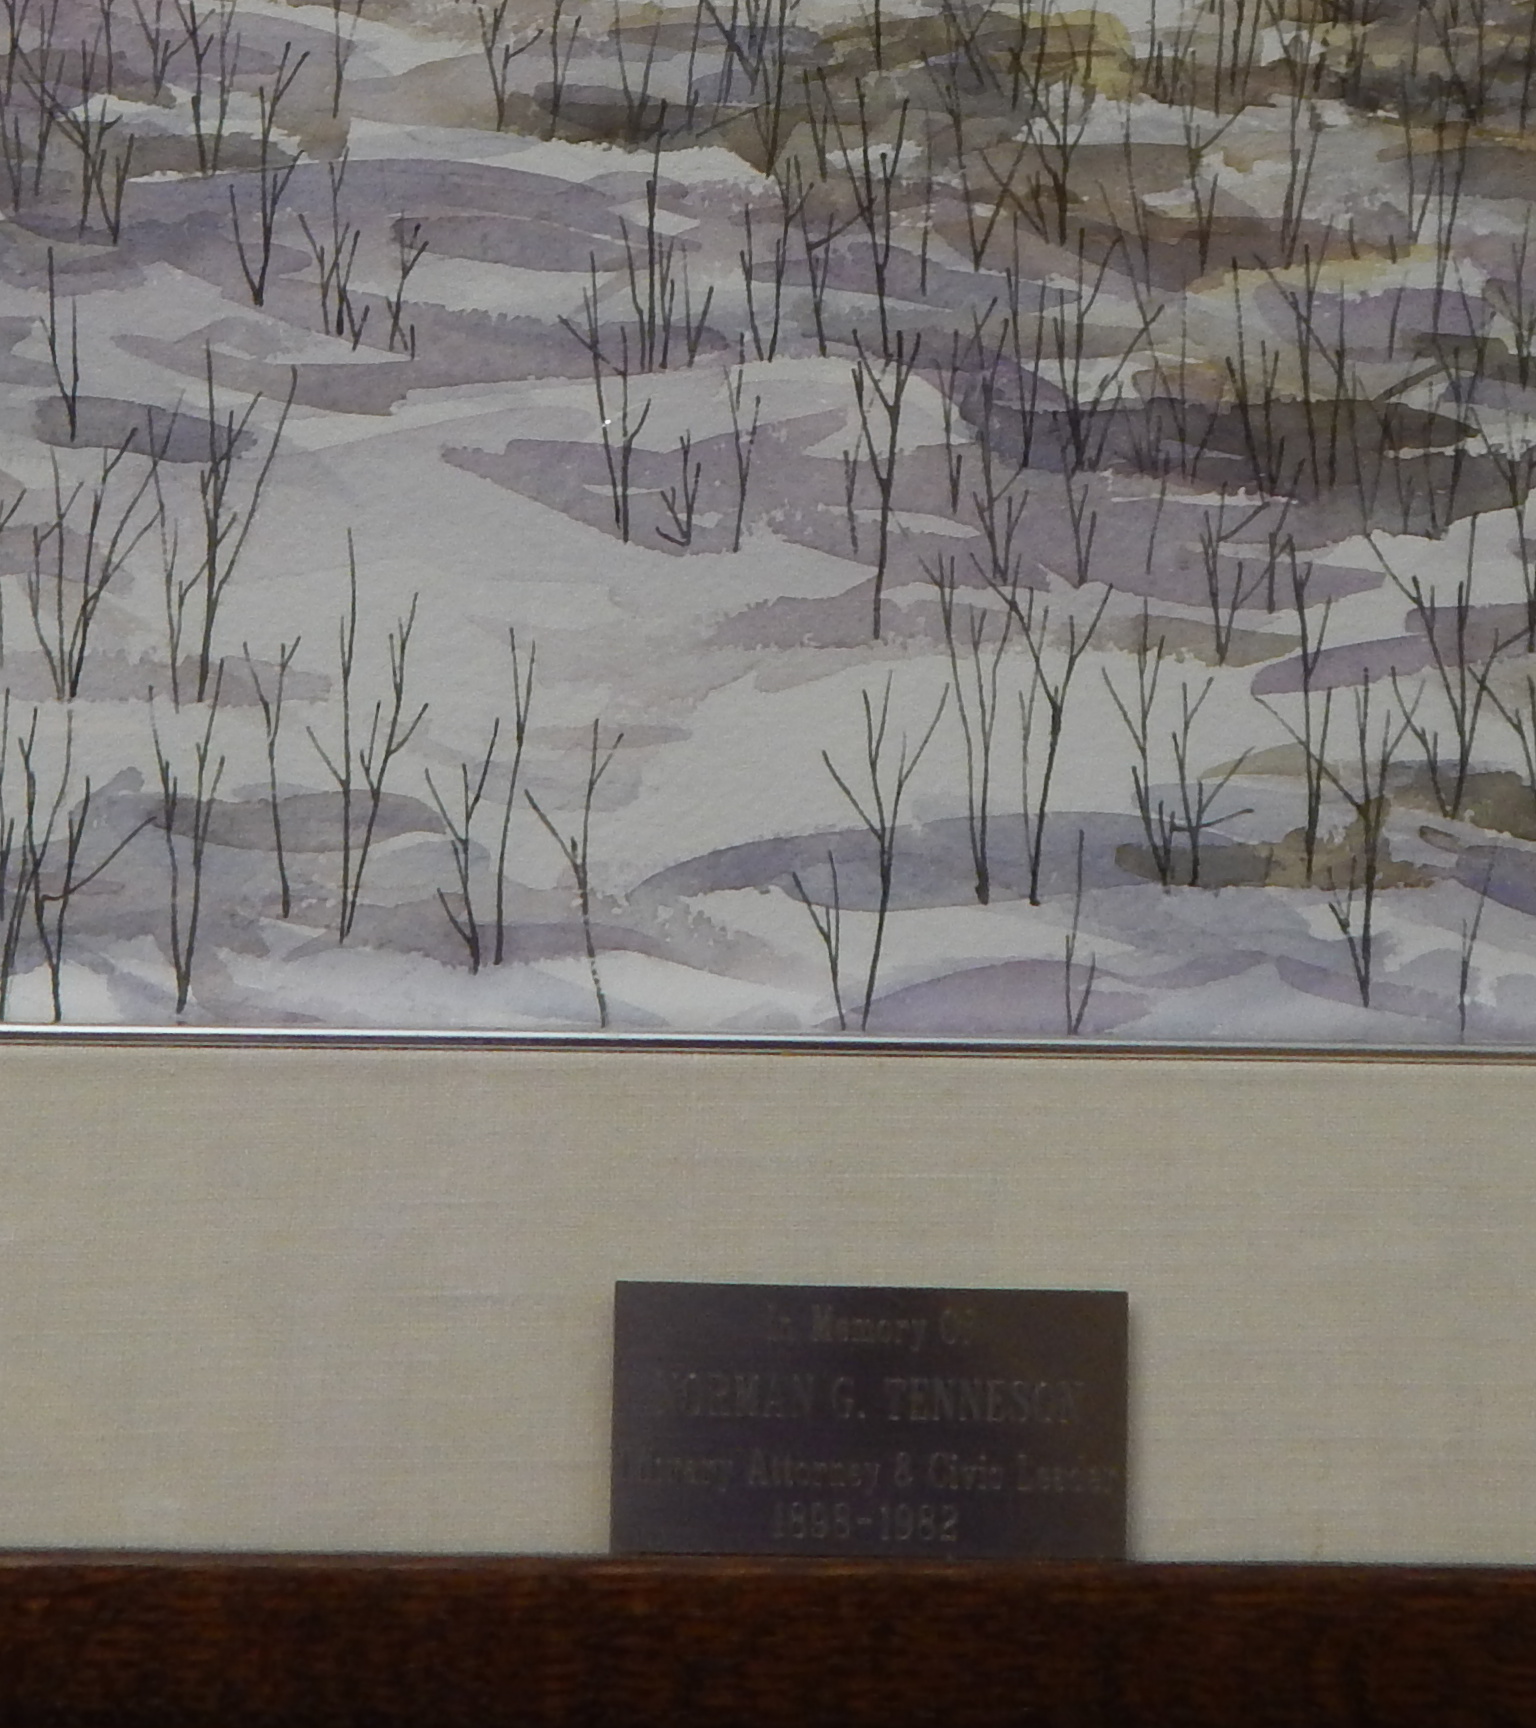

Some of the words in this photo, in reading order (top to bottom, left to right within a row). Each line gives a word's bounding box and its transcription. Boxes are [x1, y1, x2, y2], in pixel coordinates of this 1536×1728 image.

[810, 1304, 928, 1353] Memory
[831, 1374, 868, 1421] G.
[746, 1446, 882, 1496] Attorney
[893, 1450, 915, 1489] &
[927, 1450, 1005, 1492] Civic
